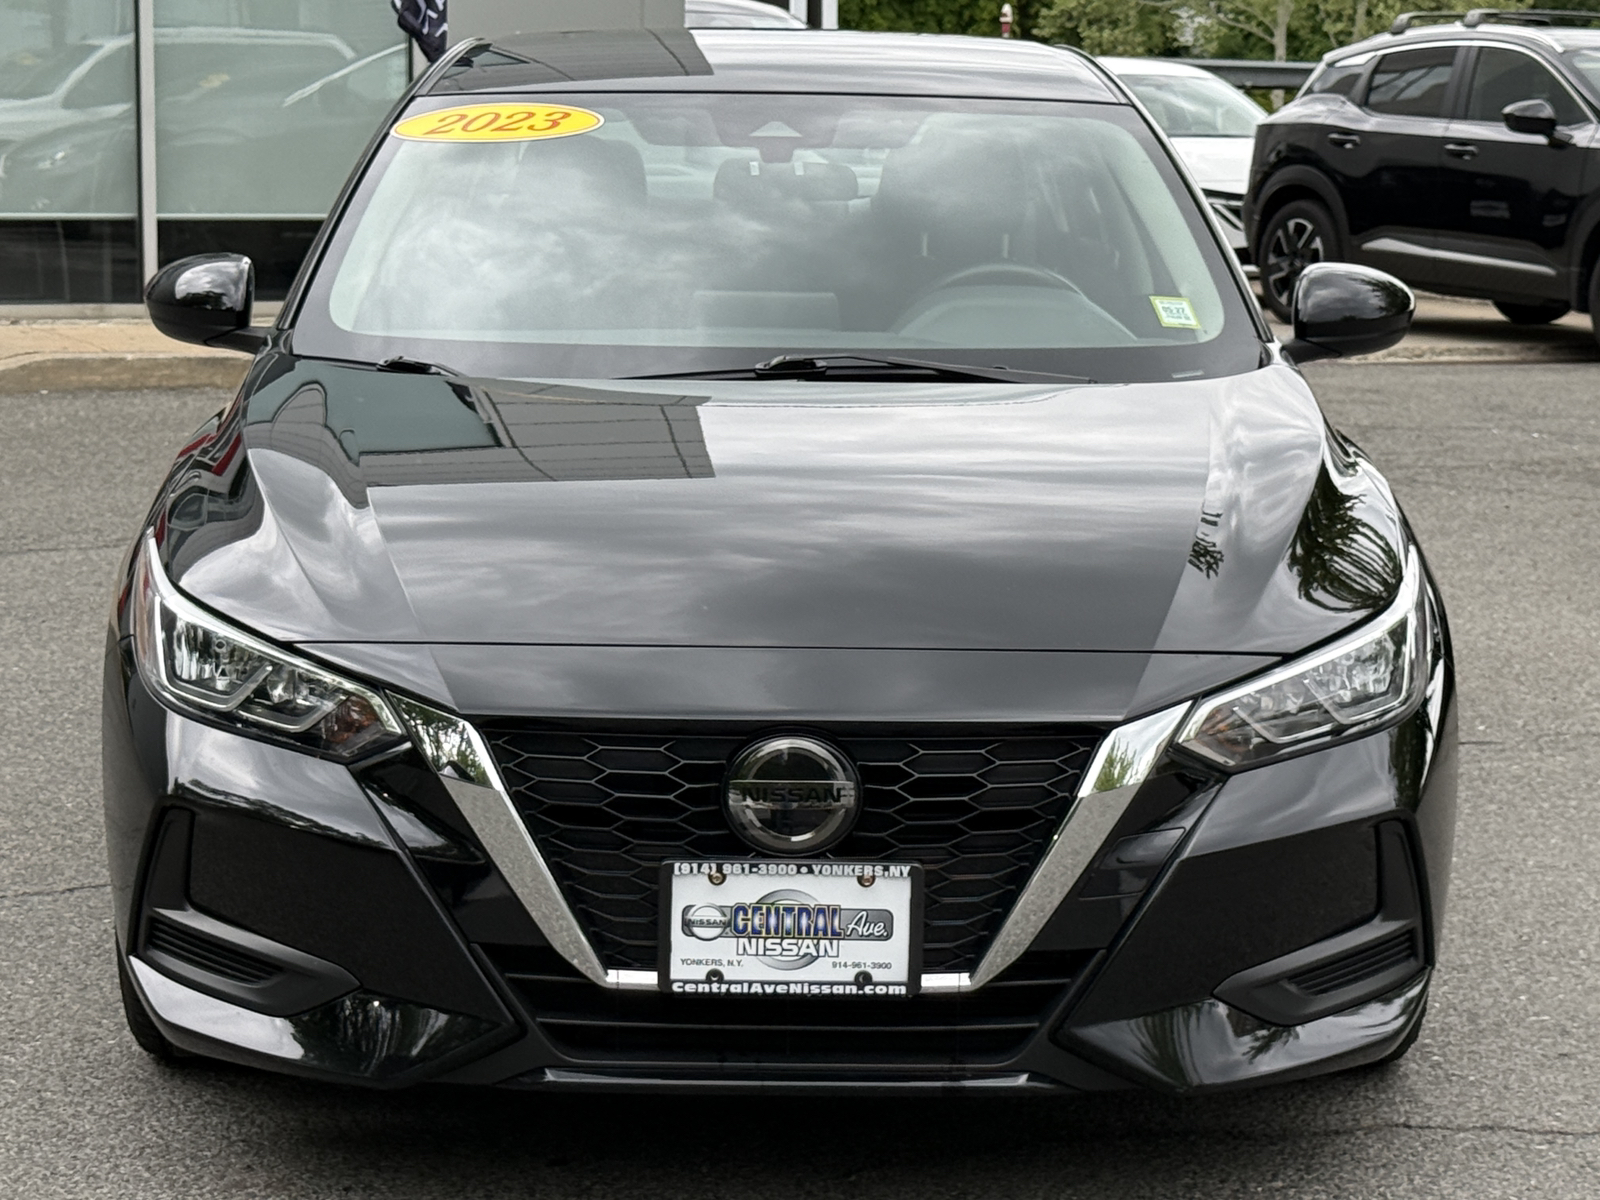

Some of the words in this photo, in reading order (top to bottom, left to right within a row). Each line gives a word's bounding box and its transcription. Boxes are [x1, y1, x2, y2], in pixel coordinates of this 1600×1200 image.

[422, 111, 572, 135] 2023
[741, 786, 841, 803] NISSAN
[688, 918, 727, 927] NISSAN
[731, 902, 844, 938] CENTRAL
[846, 910, 888, 937] Ave.
[736, 938, 839, 957] NISSAN
[680, 958, 726, 968] YONKERS,
[671, 982, 907, 995] CentralAveNissan.com
